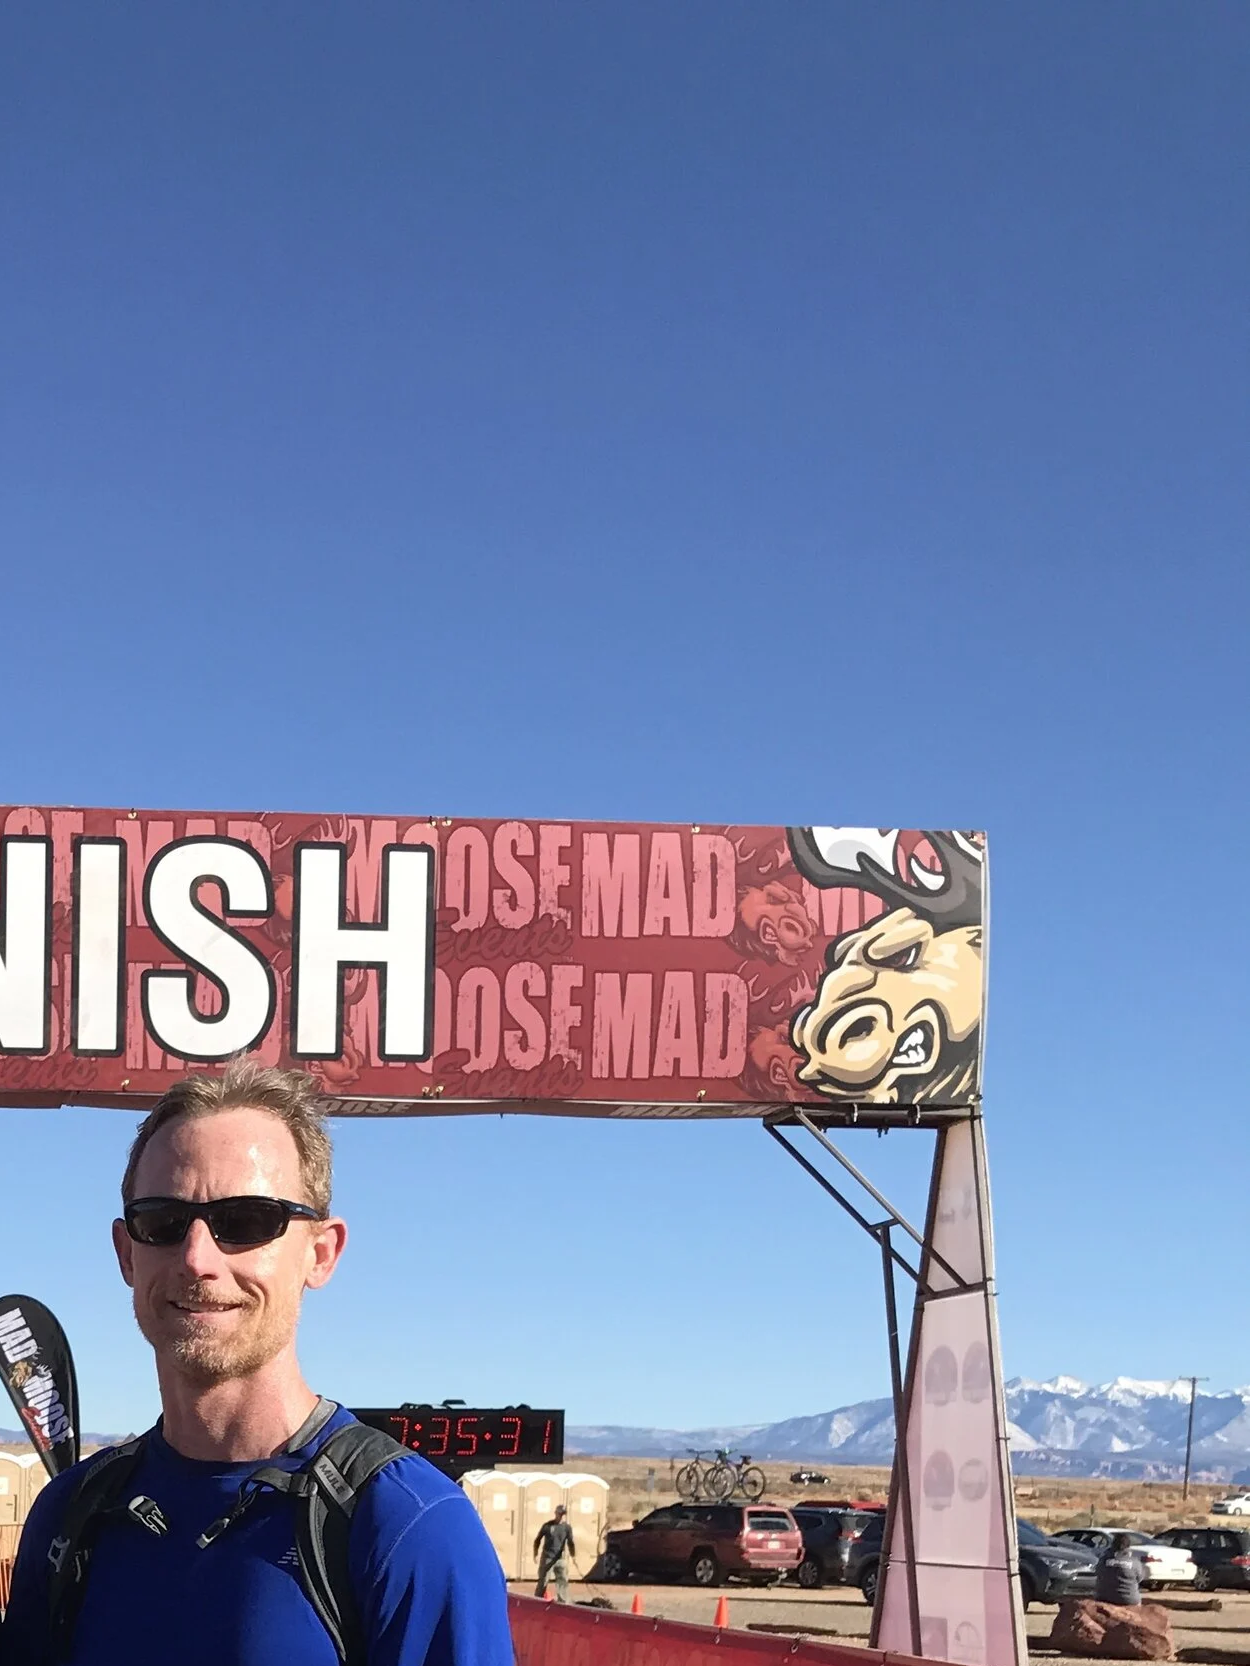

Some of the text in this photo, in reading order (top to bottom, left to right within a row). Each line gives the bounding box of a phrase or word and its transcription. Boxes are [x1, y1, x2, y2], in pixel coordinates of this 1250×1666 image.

[581, 829, 738, 938] MAD
[593, 970, 751, 1081] MAD
[318, 1462, 347, 1497] MULE
